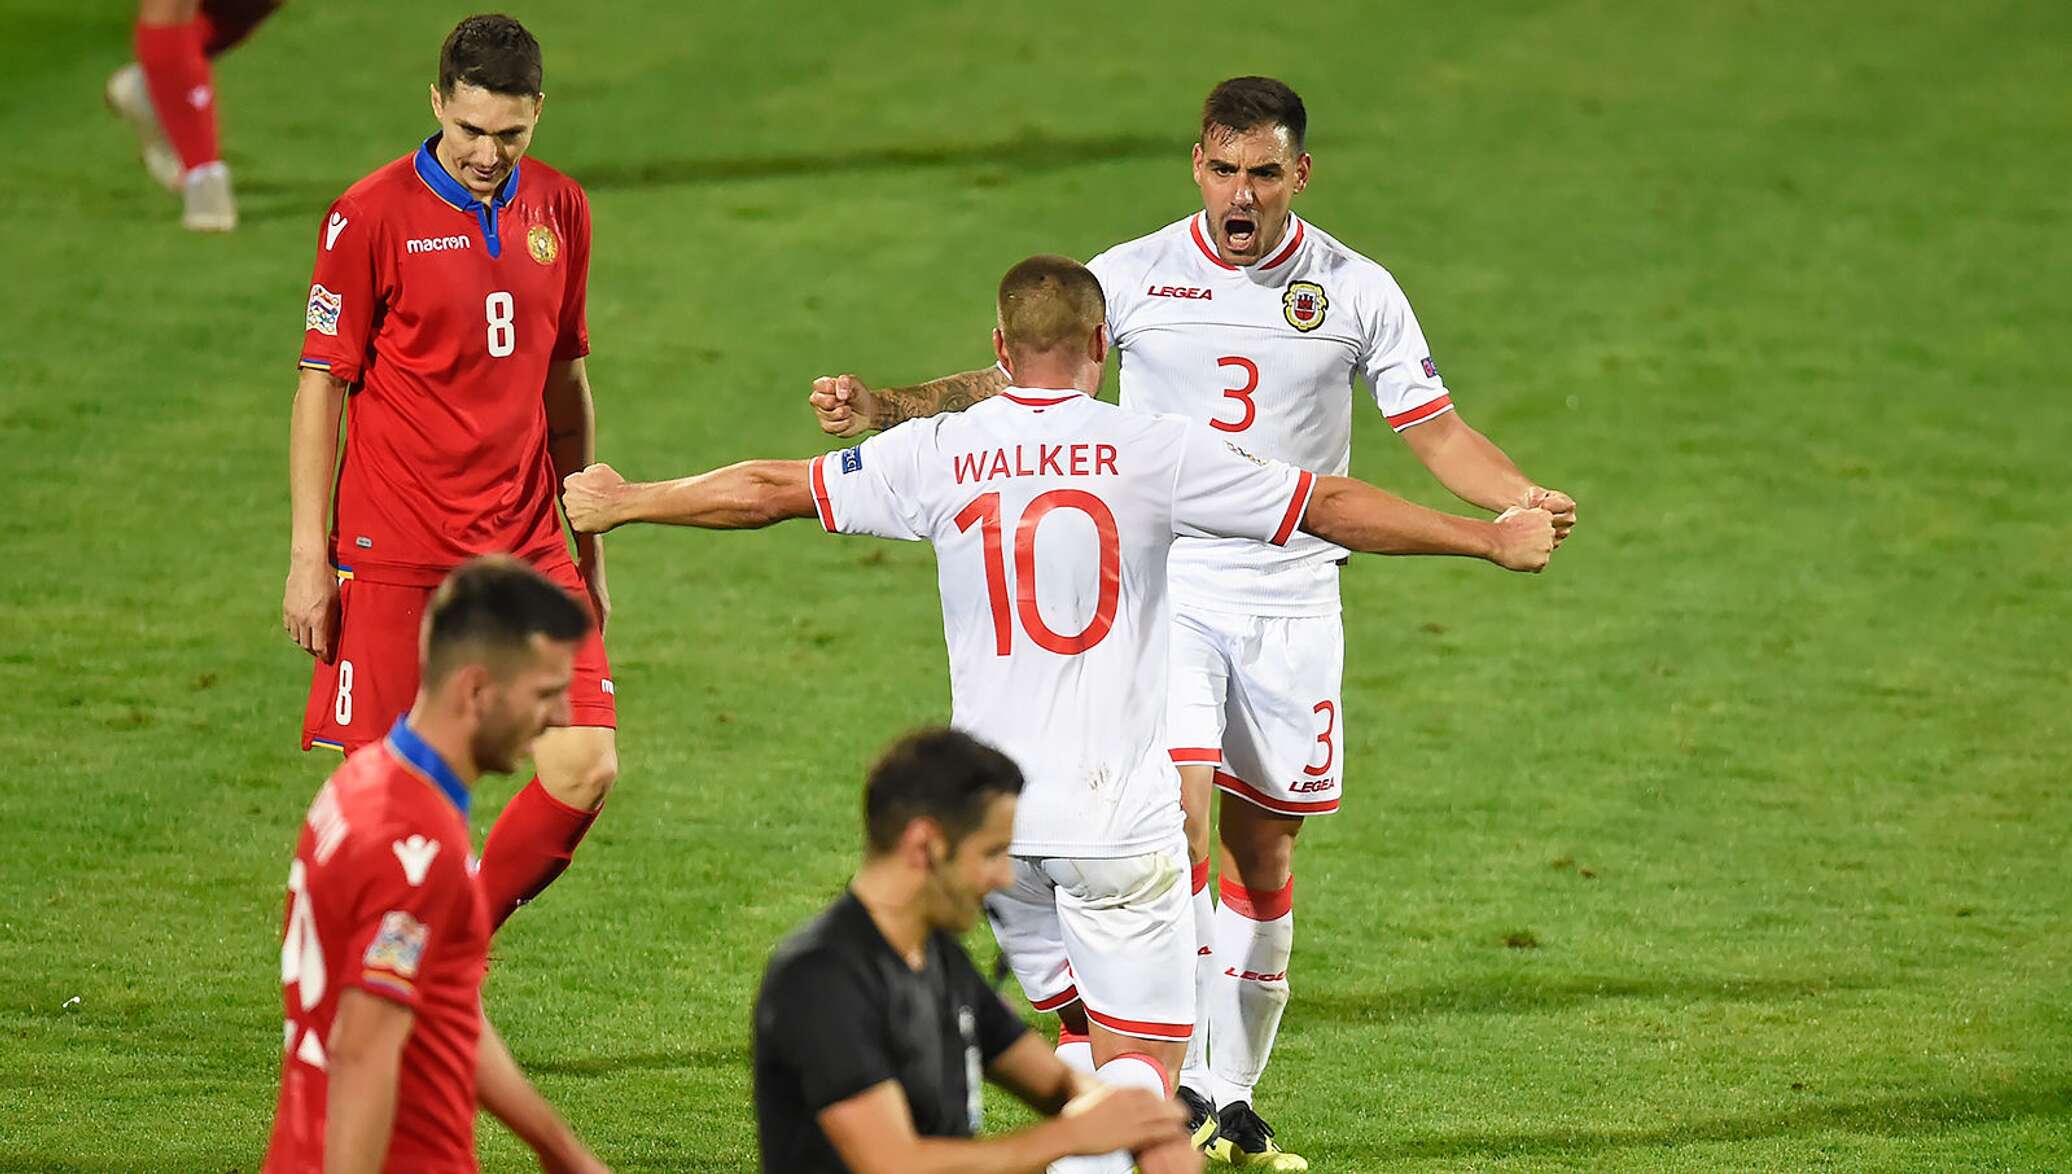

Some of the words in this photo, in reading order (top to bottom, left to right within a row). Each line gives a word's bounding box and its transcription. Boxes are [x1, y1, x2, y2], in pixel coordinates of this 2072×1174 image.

[407, 235, 470, 253] macron
[486, 291, 515, 358] 8
[1147, 285, 1213, 300] LEGEA
[1209, 356, 1259, 432] 3
[954, 444, 1119, 484] WALKER
[954, 489, 1120, 656] 10
[336, 660, 353, 725] 8
[1303, 700, 1334, 776] 3
